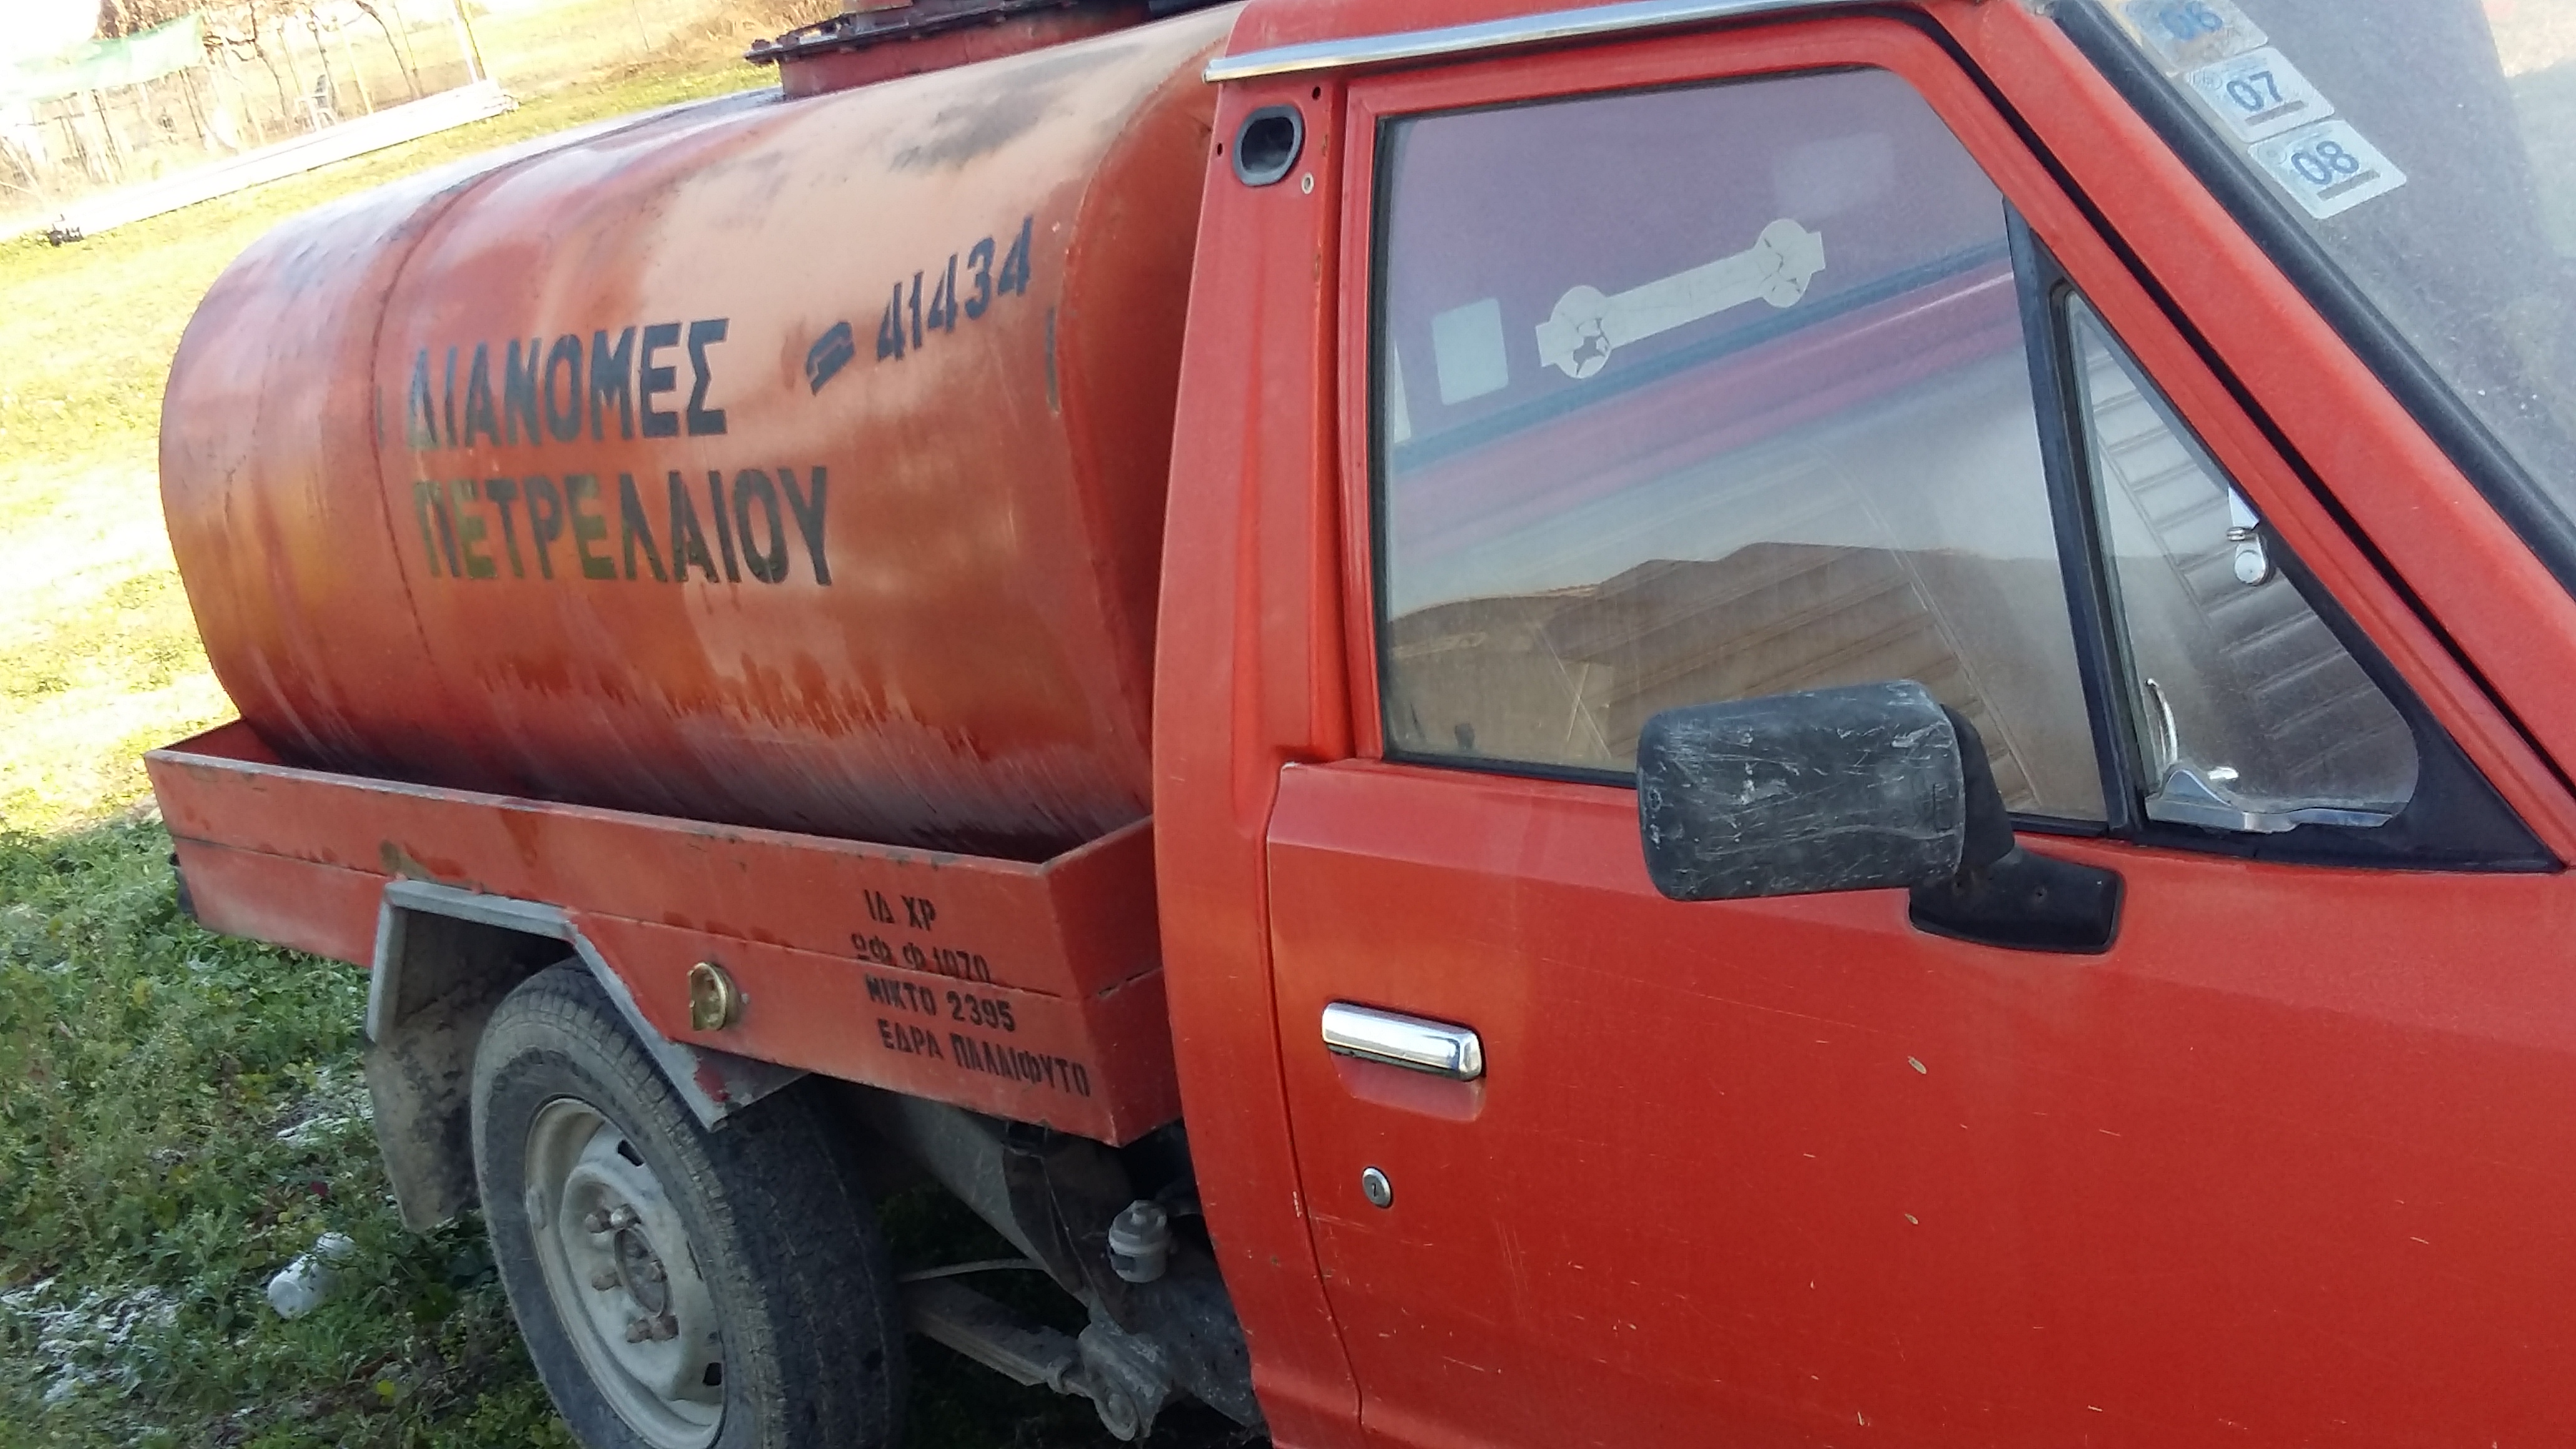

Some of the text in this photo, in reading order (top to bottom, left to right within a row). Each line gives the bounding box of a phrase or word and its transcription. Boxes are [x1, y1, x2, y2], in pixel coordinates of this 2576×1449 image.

[2225, 71, 2284, 112] 07
[2291, 140, 2359, 185] 08
[876, 215, 1034, 363] 41434
[407, 318, 730, 451] ΔΙΑΝΟΜΕΣ
[412, 466, 832, 587] ΠΕΤΡΕΛΑΙΟΥ
[865, 973, 1017, 1033] ΜΙΚΤΟ 2395
[877, 1018, 945, 1060] ΕΔΡΑ
